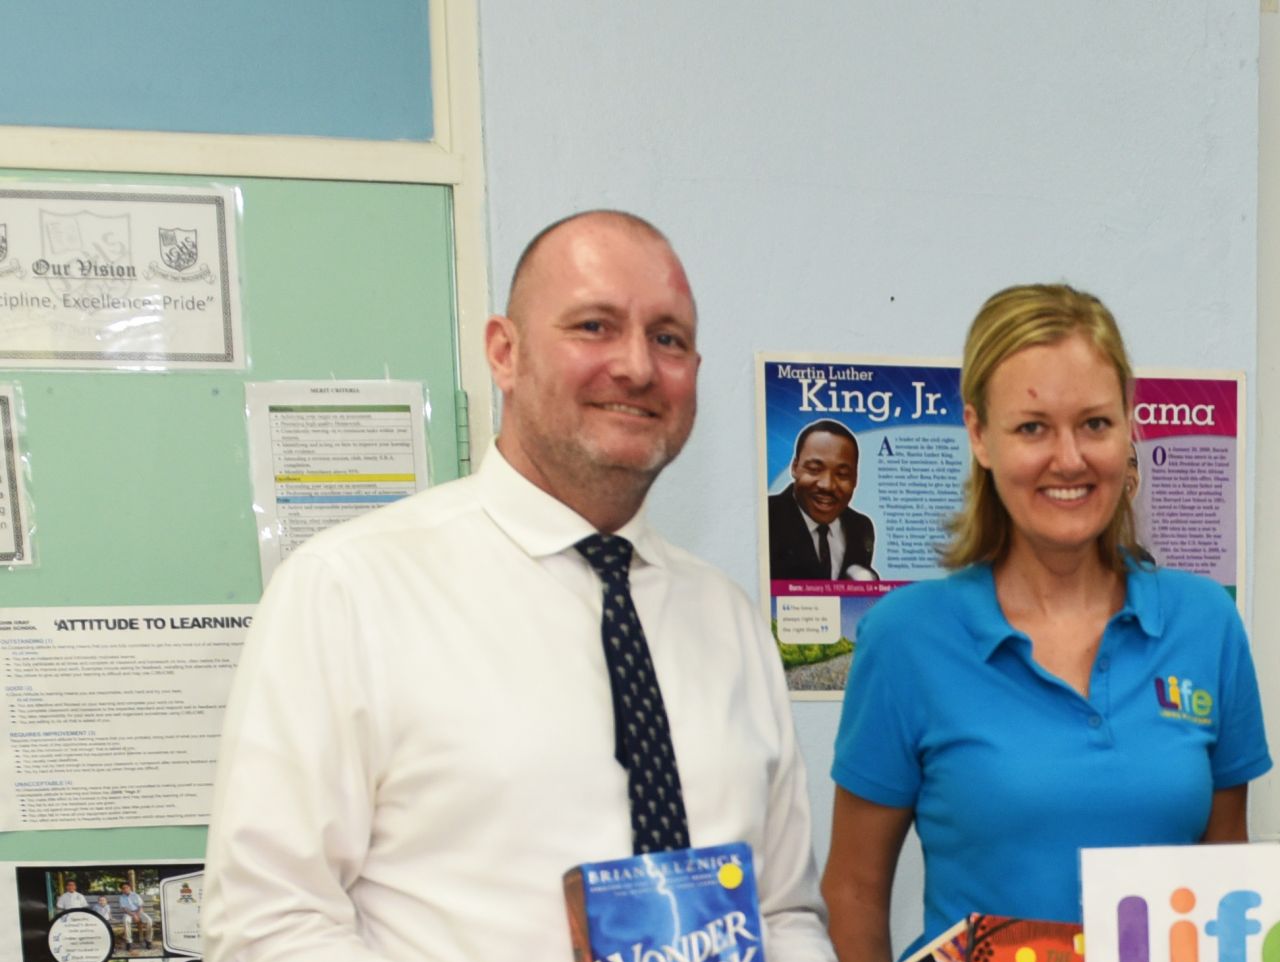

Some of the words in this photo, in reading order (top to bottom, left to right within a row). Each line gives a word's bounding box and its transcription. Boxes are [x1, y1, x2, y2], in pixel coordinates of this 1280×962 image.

[32, 259, 71, 276] Our
[77, 259, 137, 277] Vision
[778, 365, 825, 380] Martin
[828, 366, 874, 382] Luther
[798, 378, 901, 418] King,
[911, 382, 948, 416] Jr.
[143, 617, 166, 630] TO
[1154, 675, 1213, 717] Life
[587, 866, 646, 885] BRIAN
